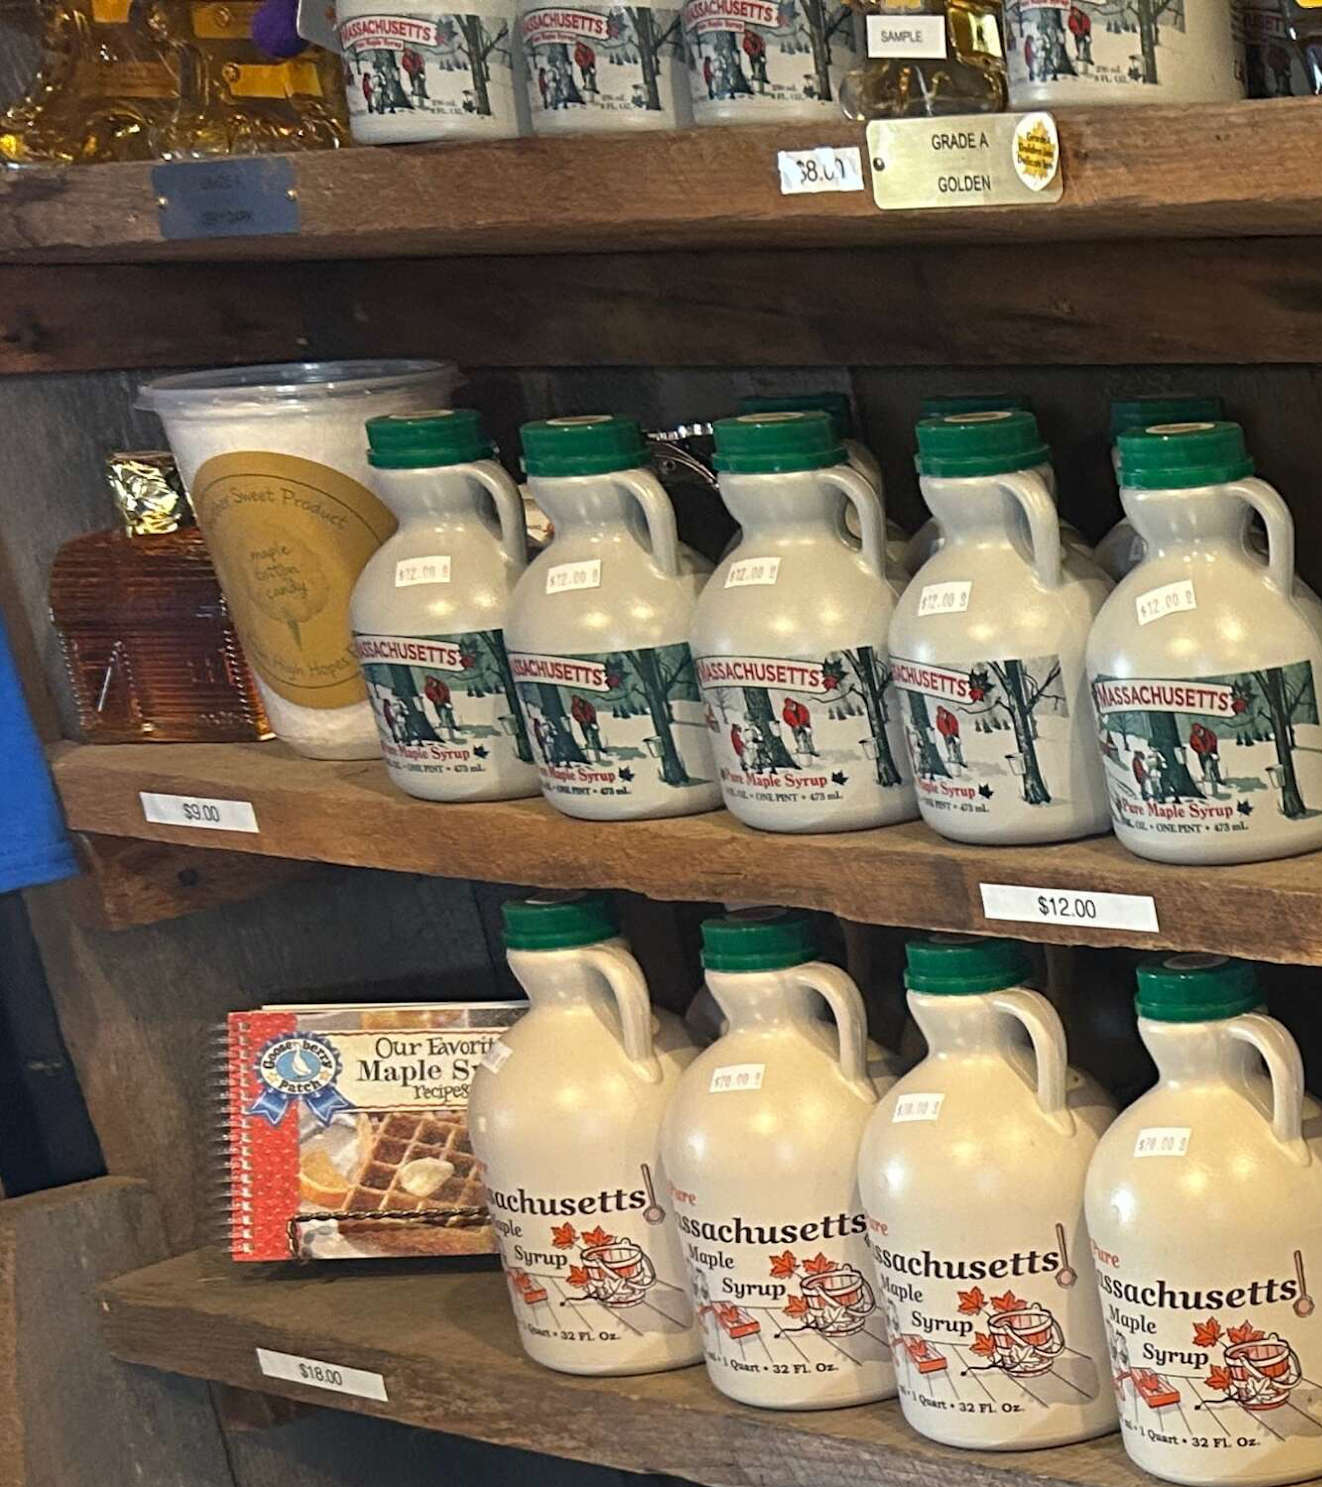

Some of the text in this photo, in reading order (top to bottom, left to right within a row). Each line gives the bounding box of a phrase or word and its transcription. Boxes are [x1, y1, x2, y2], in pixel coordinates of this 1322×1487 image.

[881, 30, 923, 42] SAMPLE
[932, 132, 989, 150] GRADE A
[938, 176, 990, 192] GOLDEN
[183, 803, 219, 822] $9.00
[1037, 896, 1096, 918] $12.00
[376, 1037, 496, 1059] Our Favorit
[357, 1059, 441, 1087] Maple
[299, 1363, 342, 1386] $18.00
